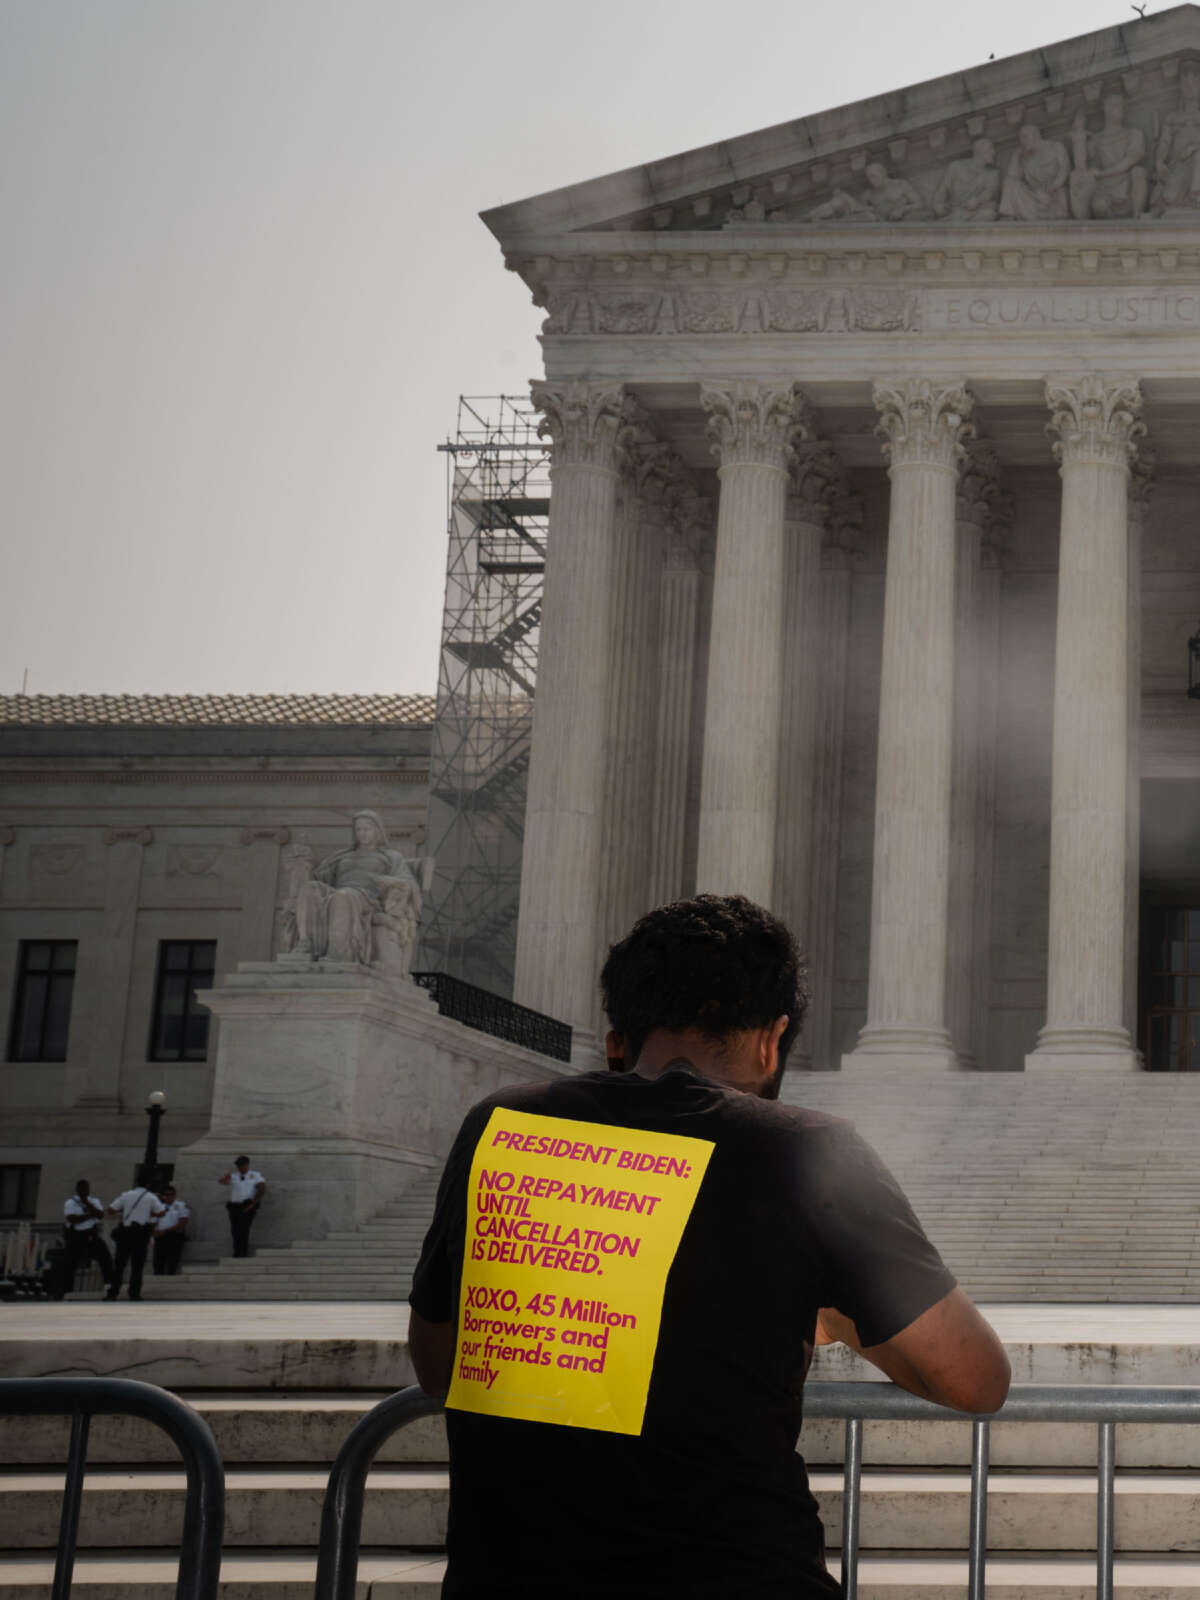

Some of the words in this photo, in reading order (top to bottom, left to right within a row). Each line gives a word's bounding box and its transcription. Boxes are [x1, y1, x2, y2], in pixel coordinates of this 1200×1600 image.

[946, 298, 1064, 325] EQUAL
[491, 1130, 617, 1166] PRESIDENT
[617, 1150, 693, 1180] BIDEN:
[476, 1192, 531, 1218] UNTIL
[478, 1169, 515, 1192] NO
[517, 1176, 662, 1216] REPAYMENT
[475, 1216, 641, 1257] CANCELLATION
[471, 1240, 489, 1261] IS
[488, 1243, 604, 1276] DELIVERED.
[466, 1286, 522, 1316] XOXO,
[526, 1293, 556, 1317] 45
[559, 1297, 637, 1329] Million
[463, 1310, 556, 1342] Borrowers
[561, 1327, 610, 1350] and
[458, 1359, 499, 1390] family
[461, 1339, 482, 1357] our
[483, 1337, 552, 1367] friends
[556, 1352, 607, 1374] and
